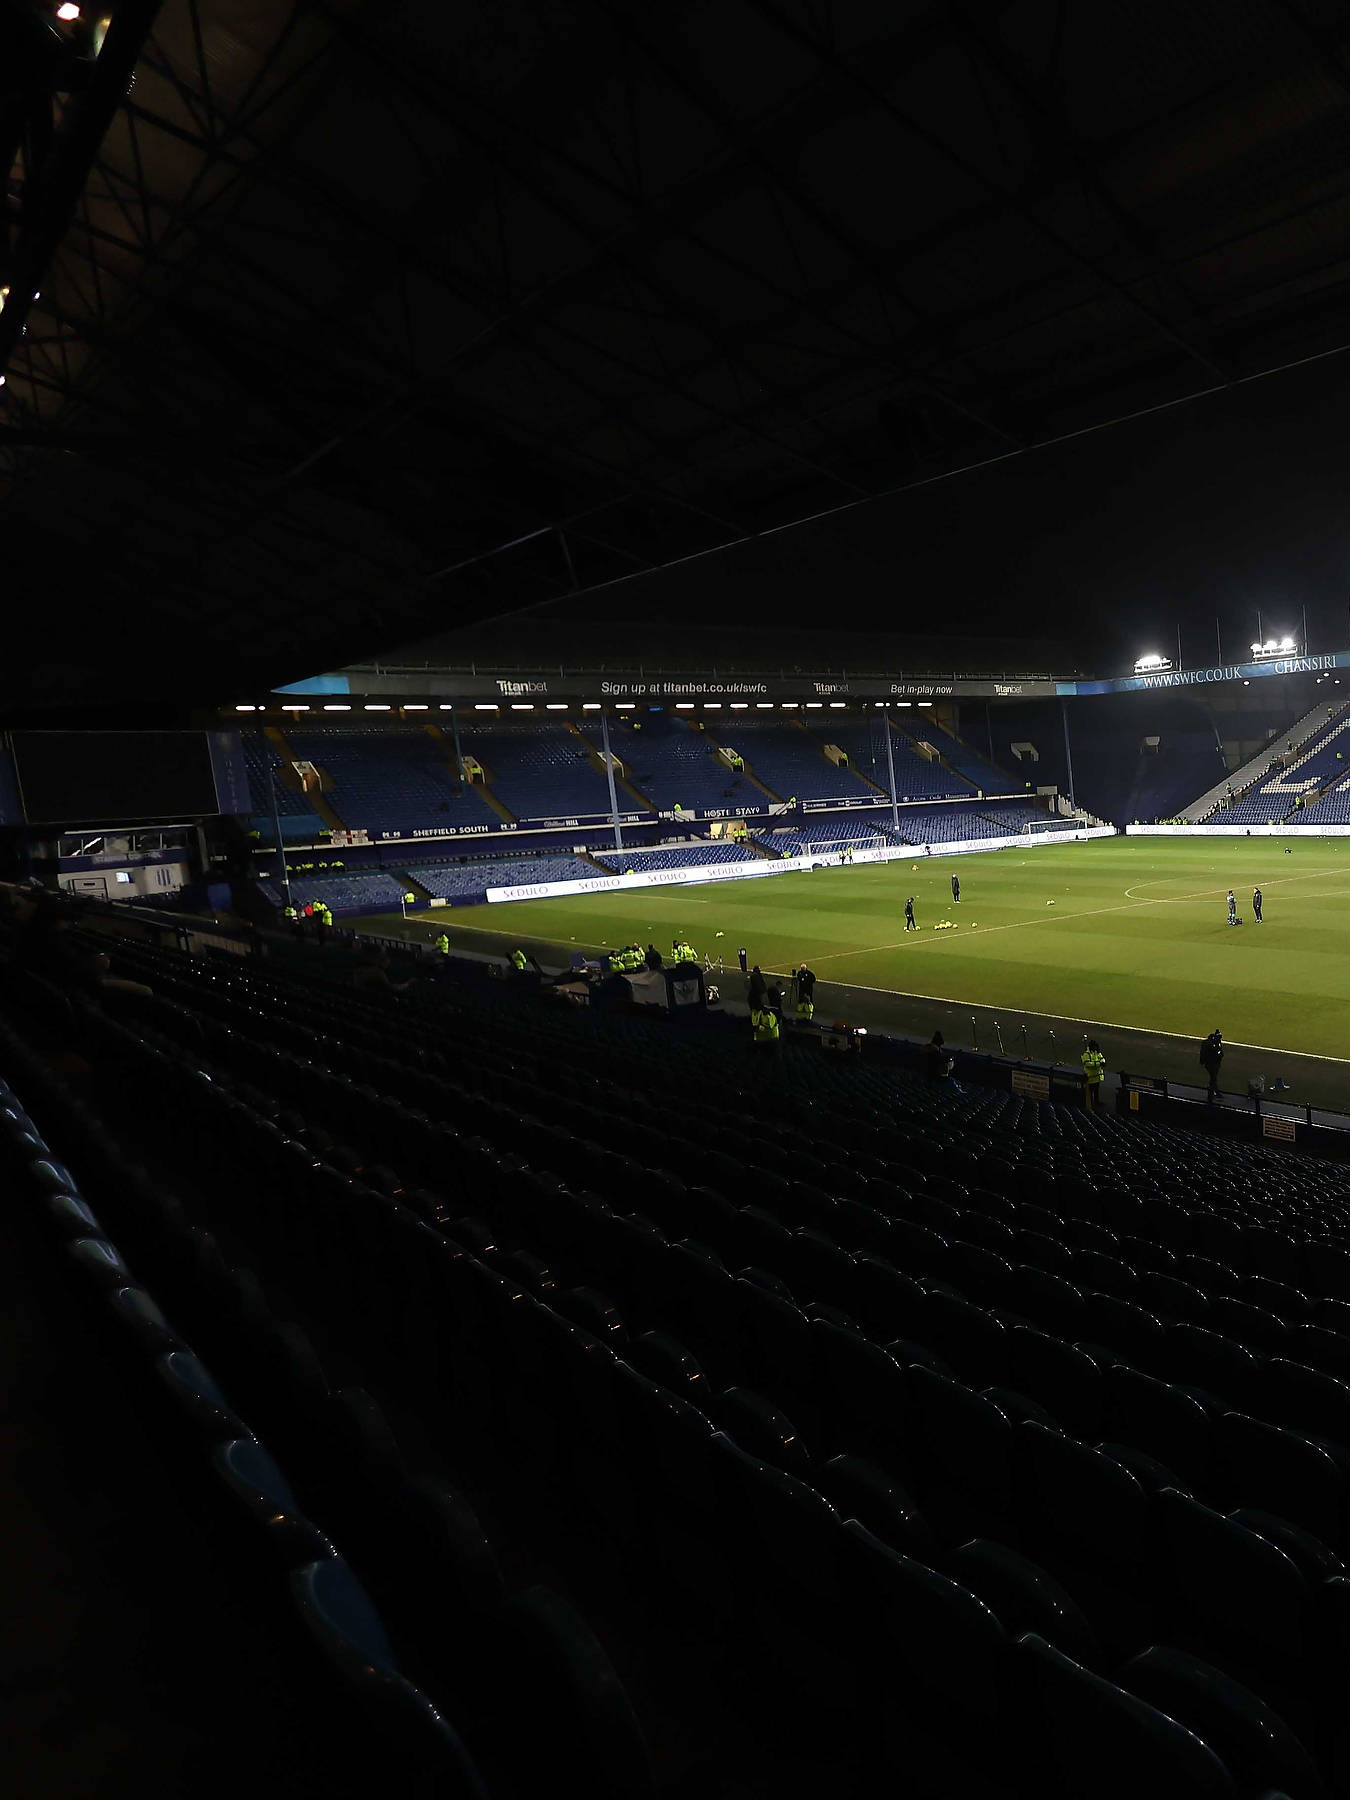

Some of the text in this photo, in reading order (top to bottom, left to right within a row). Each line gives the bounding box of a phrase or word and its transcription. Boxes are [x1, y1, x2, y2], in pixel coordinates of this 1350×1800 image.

[1274, 656, 1337, 675] CHANSIRI
[1143, 666, 1241, 688] WWW.SWFC.CO.UK
[496, 680, 547, 693] Titanbet
[601, 681, 767, 695] Sign up at titanbet.co.uk/swfc
[813, 682, 849, 692] Titanbet
[891, 685, 905, 694] Bet
[906, 685, 933, 695] in-play
[994, 684, 1023, 694] Titanbet
[412, 825, 489, 837] SHEFFIELD SOUTH
[707, 866, 743, 876] SEDULO
[767, 860, 799, 871] SEDULO
[647, 871, 687, 883] SEDULO
[578, 878, 621, 889] SEDULO
[503, 886, 548, 898] SEDULO
